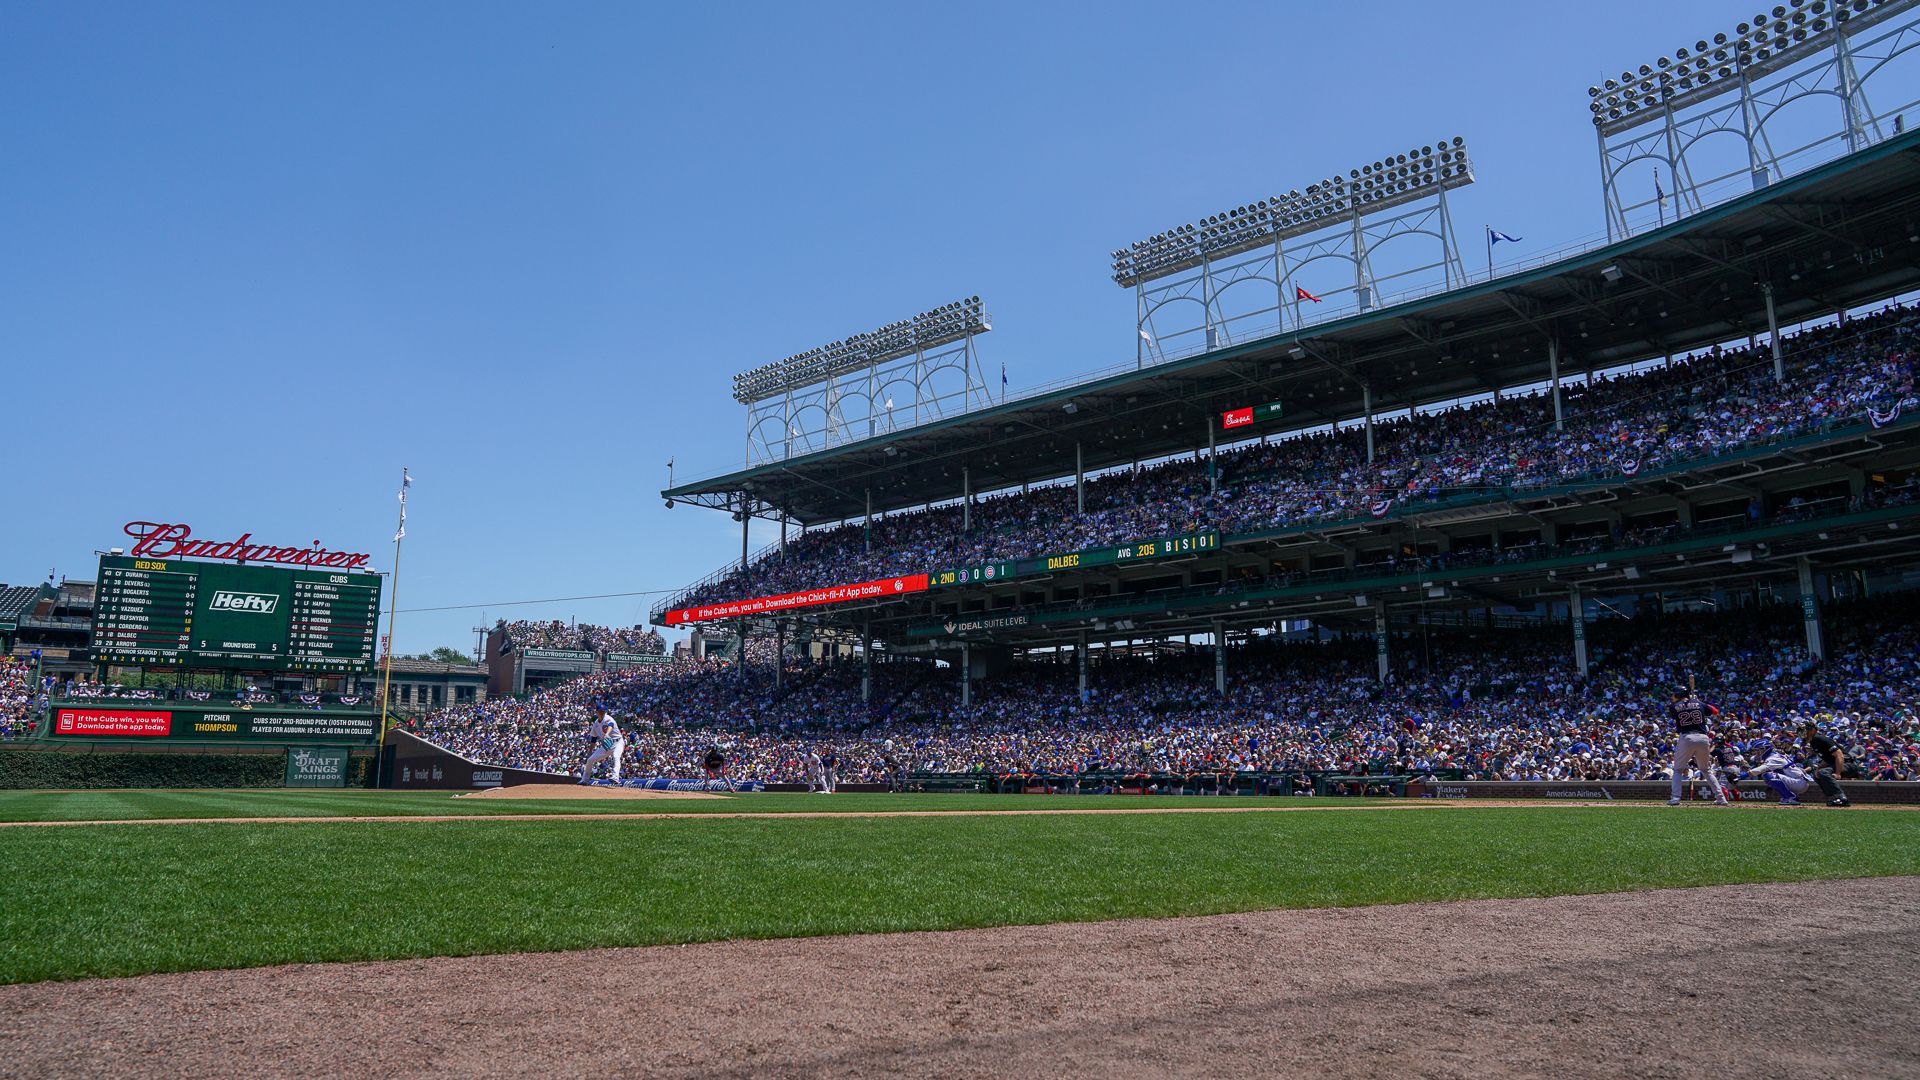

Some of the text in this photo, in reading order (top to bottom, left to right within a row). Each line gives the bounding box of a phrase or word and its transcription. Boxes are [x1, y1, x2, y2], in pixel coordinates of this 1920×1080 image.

[123, 521, 371, 568] Budweiser
[1165, 541, 1172, 552] B
[1182, 539, 1189, 549] S
[1117, 544, 1155, 559] AVG .205
[134, 561, 167, 570] RED SOX
[1048, 554, 1079, 569] DALBEC
[330, 575, 348, 583] CUBS
[940, 572, 955, 584] 2ND
[974, 569, 979, 579] 0
[214, 594, 274, 612] Hefty
[713, 607, 727, 615] Cubs
[728, 605, 740, 613] win,
[740, 605, 751, 613] you
[765, 598, 796, 607] Download
[796, 595, 808, 603] the
[846, 589, 860, 598] App
[861, 585, 882, 595] today.
[958, 616, 1028, 631] IDEAL SUITE LEVEL
[527, 650, 592, 659] WRIGLEYROOFTOPS.COM
[203, 714, 230, 722] PITCHER
[1677, 709, 1703, 726] 29
[194, 724, 237, 732] THOMPSON
[296, 756, 340, 766] DRAFT
[300, 765, 338, 773] KINGS
[472, 772, 503, 781] GRAINGER
[666, 780, 706, 791] Reynolds
